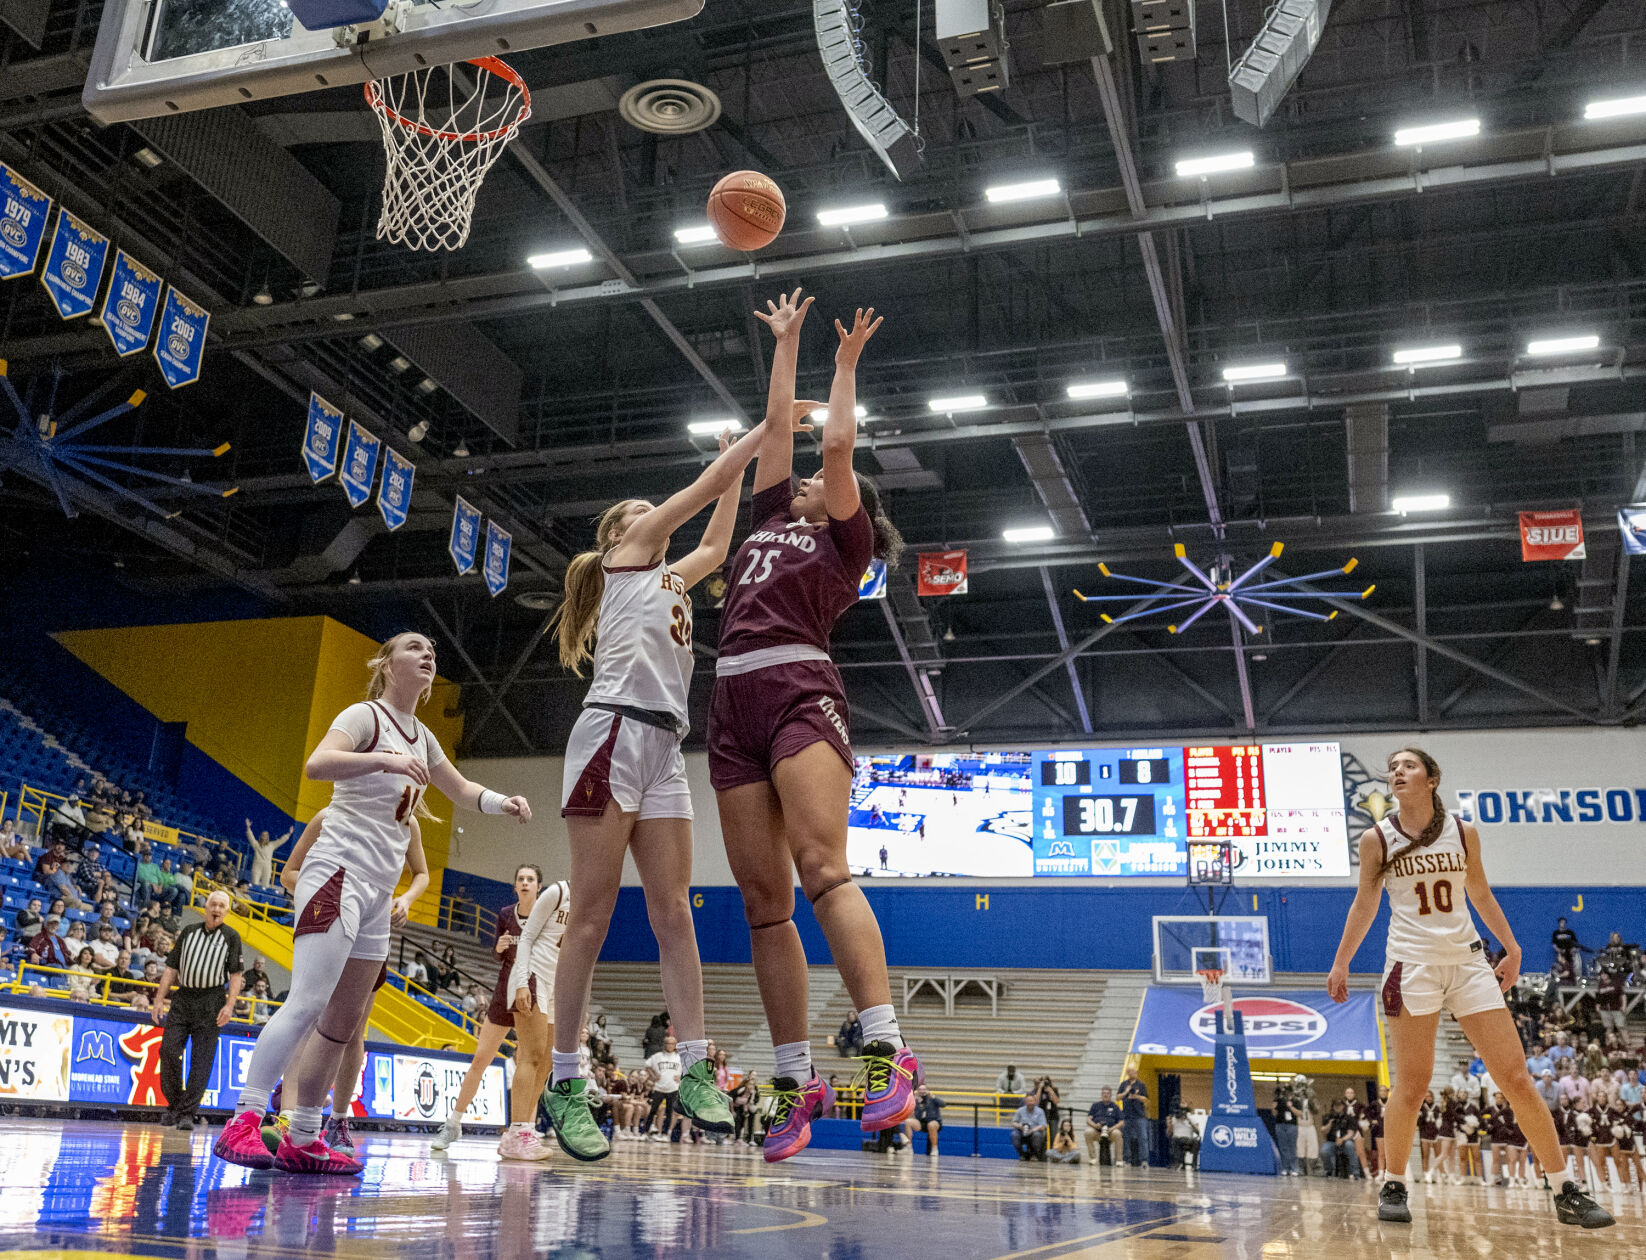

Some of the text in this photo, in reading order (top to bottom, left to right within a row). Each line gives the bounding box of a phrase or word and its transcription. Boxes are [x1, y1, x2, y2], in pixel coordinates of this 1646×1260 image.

[4, 197, 32, 228] 1979
[4, 224, 21, 241] OVC
[65, 241, 90, 269] 1983
[65, 266, 82, 282] OVC
[121, 281, 146, 309] 1984
[121, 305, 137, 321] OVC
[171, 316, 195, 342] 2003
[171, 339, 187, 354] OVC
[314, 418, 332, 441] 2009
[354, 446, 369, 466] 2011
[744, 530, 816, 553] HLAND
[1526, 526, 1579, 545] SIUE
[738, 548, 782, 585] 25
[933, 571, 964, 584] SEMO
[1055, 760, 1152, 785] 10 1 8
[1079, 798, 1138, 833] 30.7
[1256, 841, 1320, 855] JIMMY
[1257, 859, 1323, 872] JOHN'S
[1393, 852, 1464, 878] RUSSELL
[693, 893, 704, 908] G
[976, 893, 989, 910] H
[1414, 880, 1453, 916] 10
[1571, 894, 1583, 912] J
[76, 1030, 116, 1066] M
[71, 1072, 120, 1084] MOREHEAD STATE
[71, 1082, 120, 1093] UNIVERSITY
[1233, 1131, 1258, 1140] WILD
